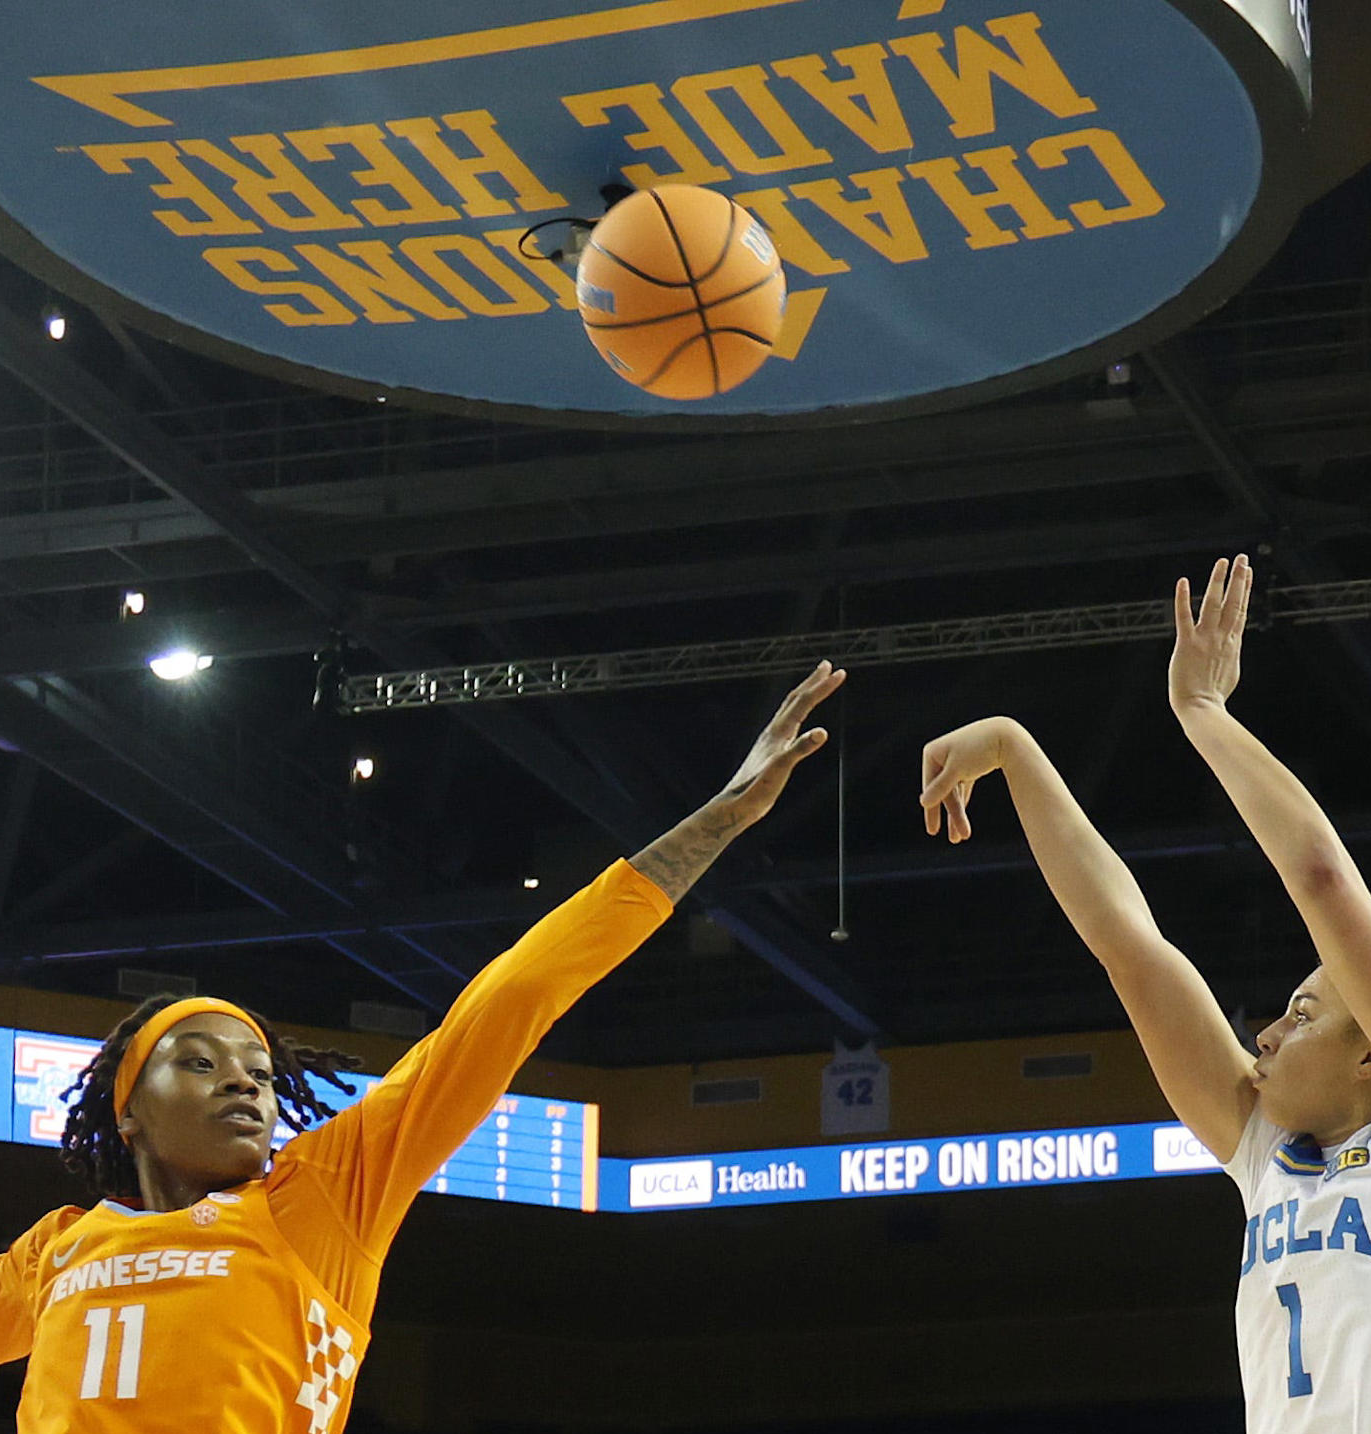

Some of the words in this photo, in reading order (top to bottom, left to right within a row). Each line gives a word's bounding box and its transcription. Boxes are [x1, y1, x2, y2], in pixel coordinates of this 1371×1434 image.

[560, 13, 1098, 188] MADE
[79, 108, 569, 237] HERE
[202, 127, 1166, 327] CHAIONS
[837, 1078, 874, 1107] 42
[497, 1149, 507, 1165] 1
[840, 1147, 929, 1193] KEEP
[938, 1140, 989, 1187] ON
[997, 1132, 1119, 1182] RISING
[1167, 1137, 1211, 1158] UCL
[496, 1185, 506, 1200] 1
[550, 1191, 560, 1206] 1
[551, 1173, 561, 1188] 1
[642, 1175, 700, 1195] UCLA
[716, 1162, 806, 1195] Health
[80, 1303, 146, 1399] 11
[1275, 1282, 1313, 1398] 1
